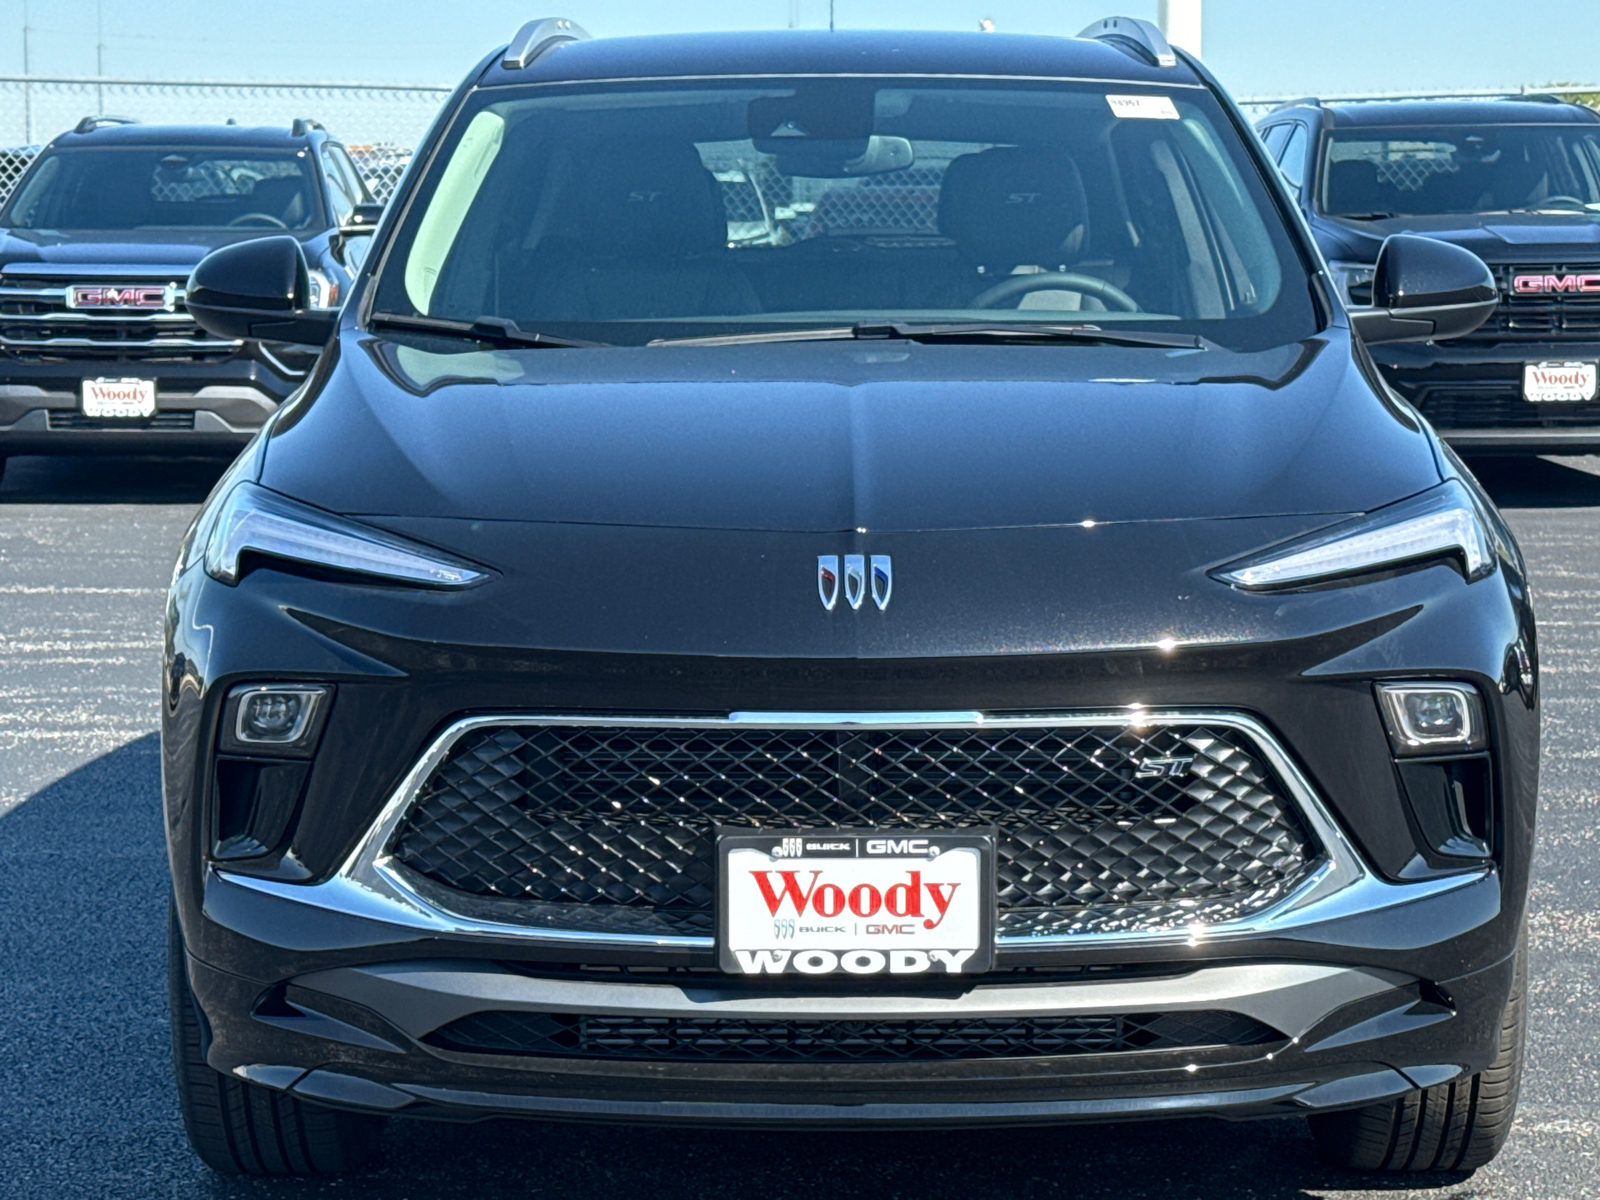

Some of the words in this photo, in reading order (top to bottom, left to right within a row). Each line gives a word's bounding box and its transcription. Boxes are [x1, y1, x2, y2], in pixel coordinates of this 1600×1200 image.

[627, 190, 662, 202] ST
[1005, 192, 1041, 204] ST
[1514, 275, 1600, 293] GMC
[75, 288, 165, 305] GMC
[1532, 371, 1590, 389] Woody
[90, 386, 148, 404] Woody
[1135, 757, 1194, 779] ST
[806, 842, 851, 851] BUICK
[866, 839, 929, 854] GMC
[749, 870, 961, 930] Woody
[865, 924, 916, 935] GMC
[735, 950, 975, 974] WOODY
